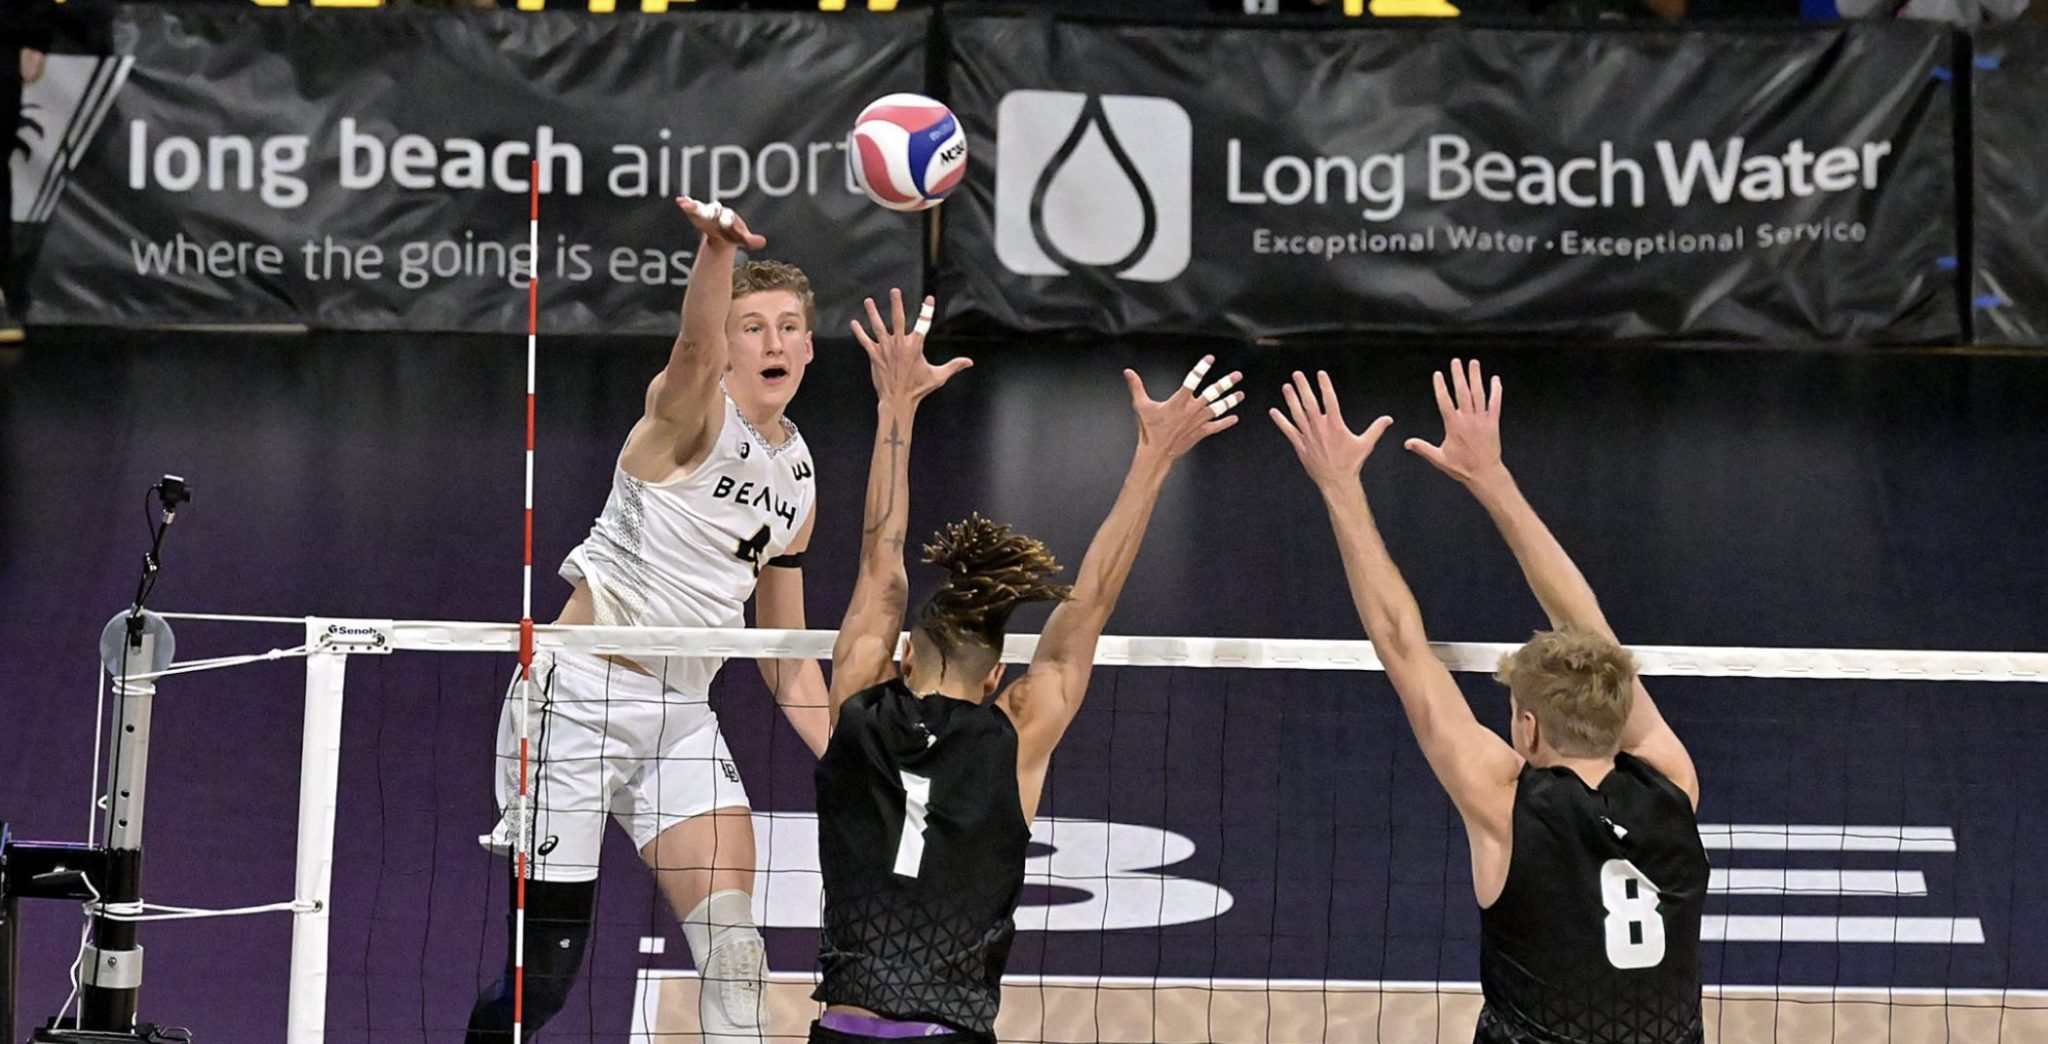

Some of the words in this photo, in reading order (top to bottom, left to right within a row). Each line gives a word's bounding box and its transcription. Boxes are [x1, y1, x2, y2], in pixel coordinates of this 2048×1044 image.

[129, 118, 309, 208] long
[338, 117, 583, 195] beach
[1227, 138, 1405, 222] Long
[1428, 134, 1646, 207] Beach
[1654, 136, 1892, 207] Water
[130, 232, 284, 279] where
[301, 234, 384, 281] the
[398, 229, 540, 289] going
[556, 234, 594, 281] is
[608, 246, 694, 286] eas
[1252, 228, 1435, 261] Exceptional
[1447, 225, 1538, 254] Water
[1560, 225, 1744, 261] Exceptional
[1756, 217, 1867, 249] Service
[338, 626, 377, 635] Senoh
[892, 769, 931, 879] 1
[1600, 858, 1666, 970] 8
